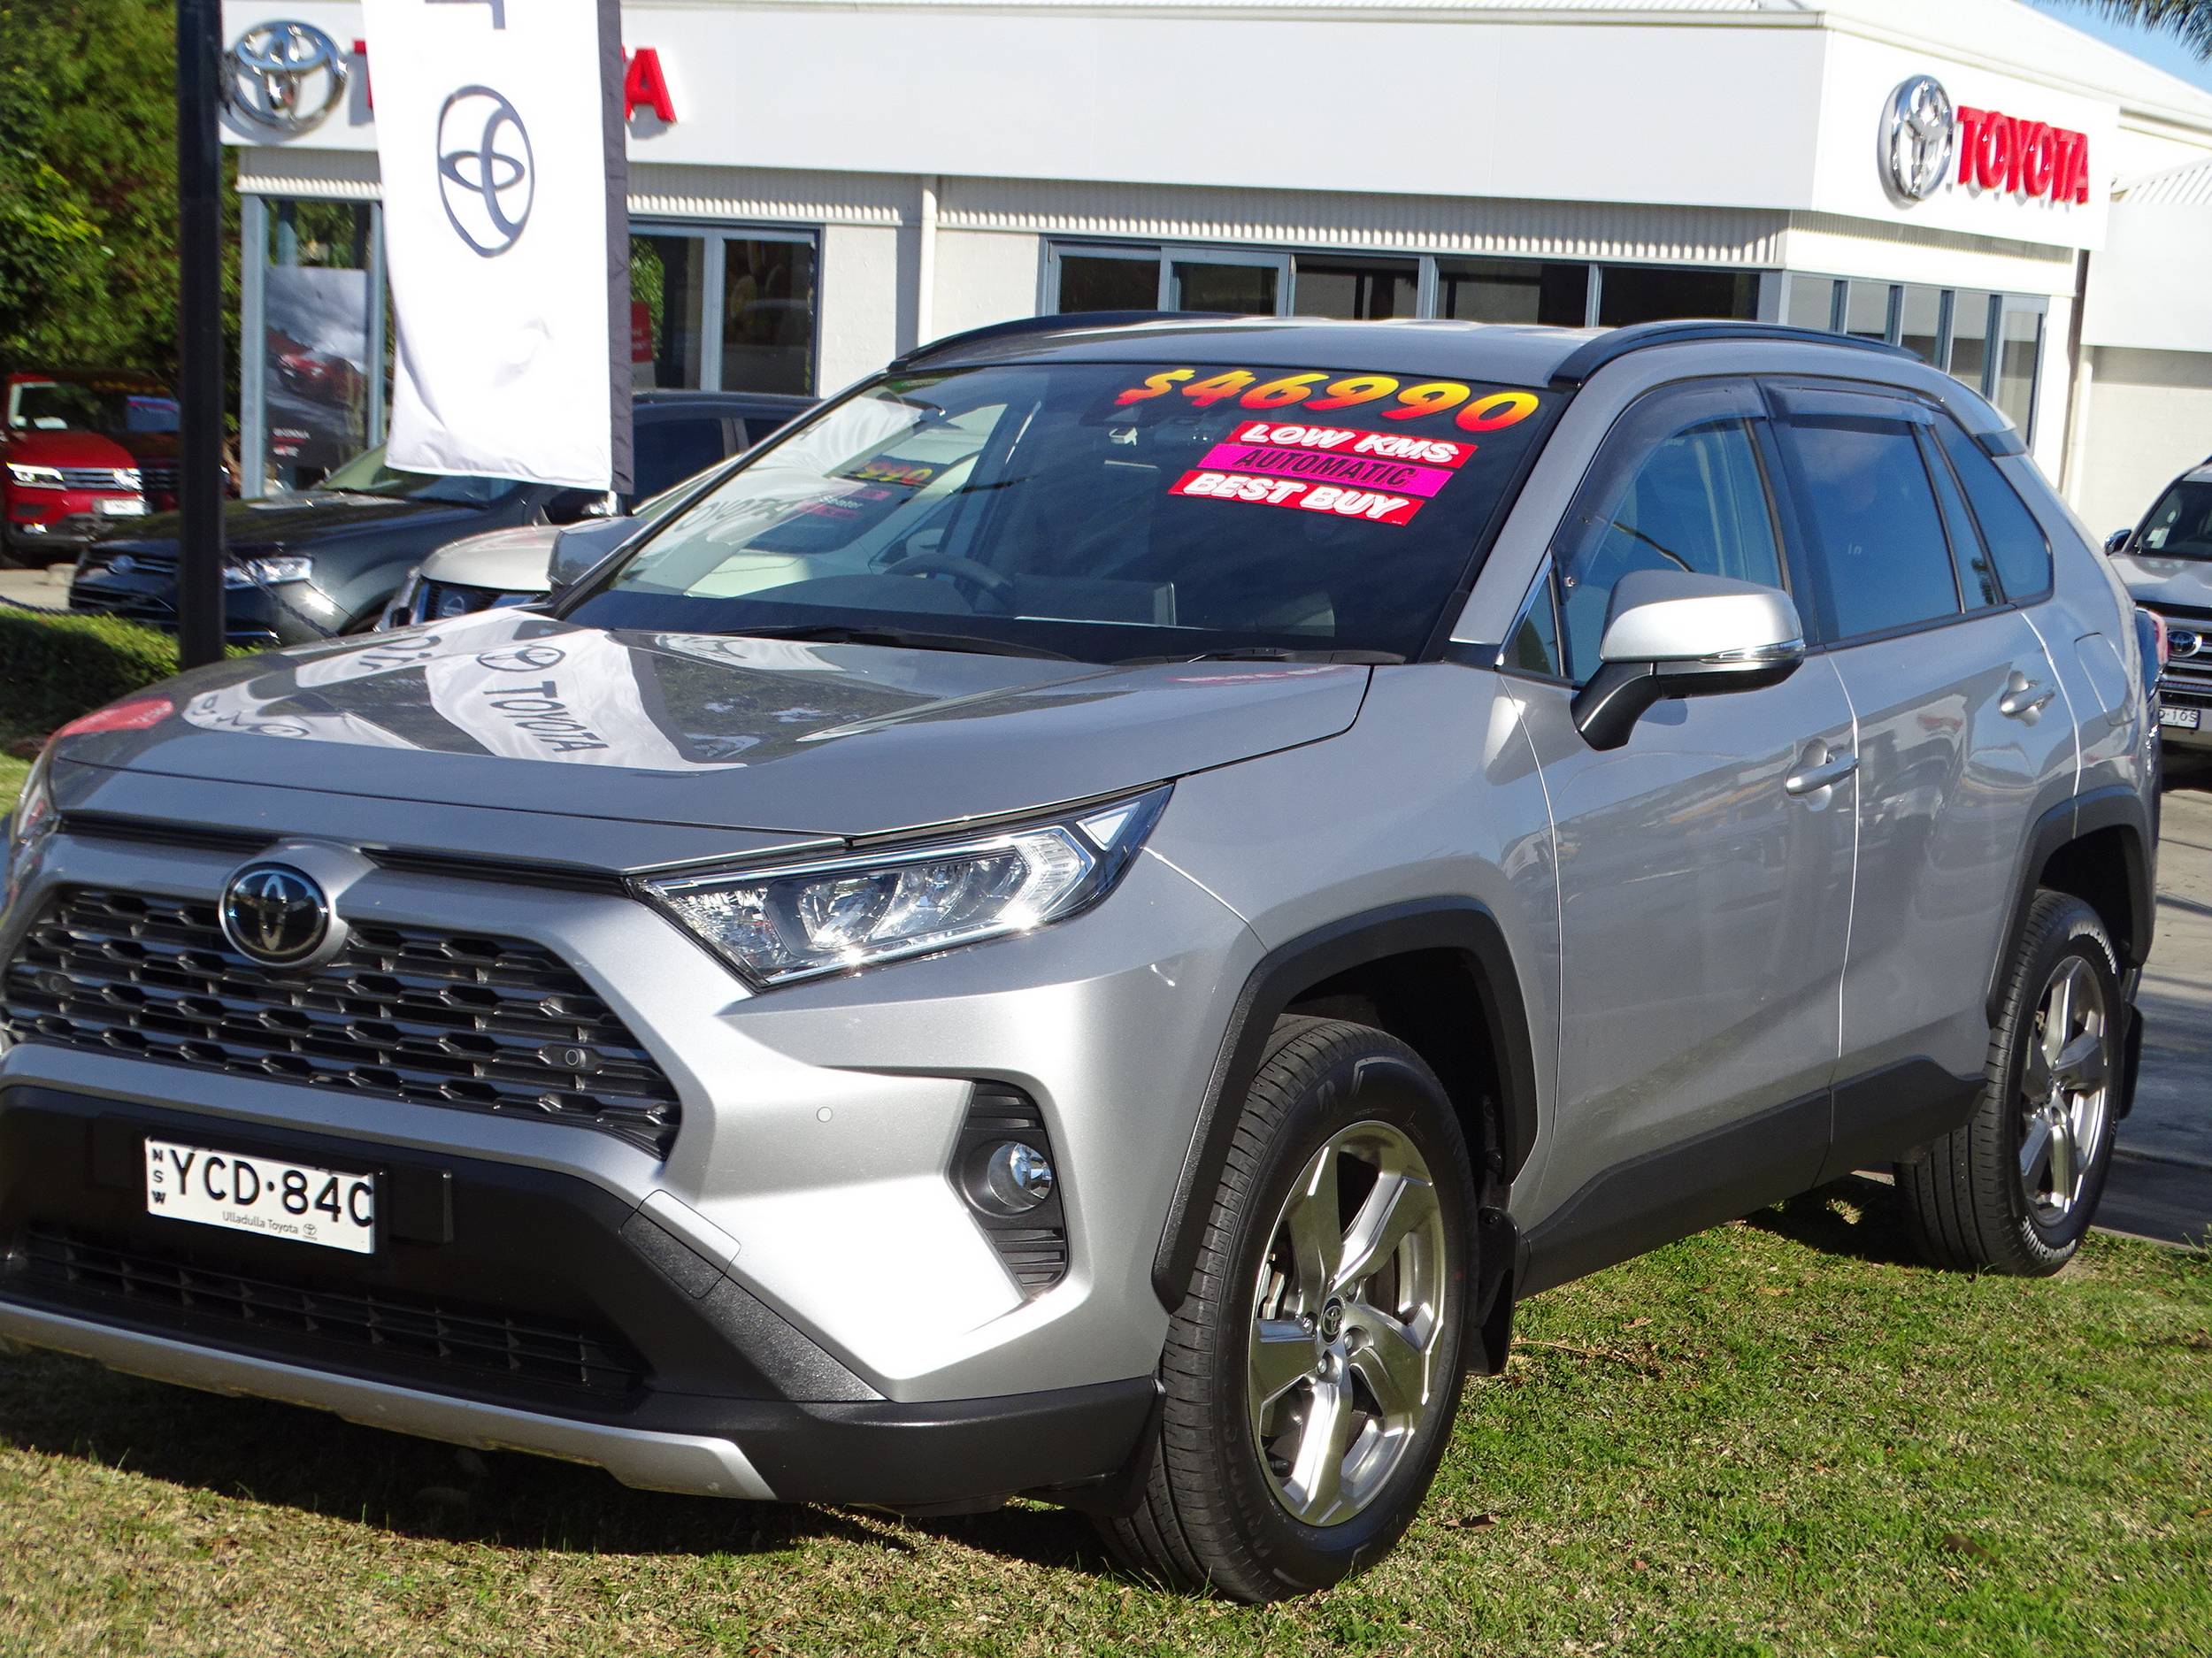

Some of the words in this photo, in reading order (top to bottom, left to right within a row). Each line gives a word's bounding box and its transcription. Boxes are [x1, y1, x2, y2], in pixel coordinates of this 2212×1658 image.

[1956, 104, 2090, 205] TOYOTA
[1114, 368, 1540, 433] $46990
[1240, 423, 1356, 448] LOW
[1354, 434, 1459, 464] KMS
[1232, 449, 1417, 487] AUTOMATIC
[1183, 472, 1308, 503] BEST
[1301, 487, 1409, 518] BUY
[483, 680, 610, 753] TOYOTA
[222, 1210, 265, 1229] Ulladulla
[268, 1219, 298, 1235] Toyota
